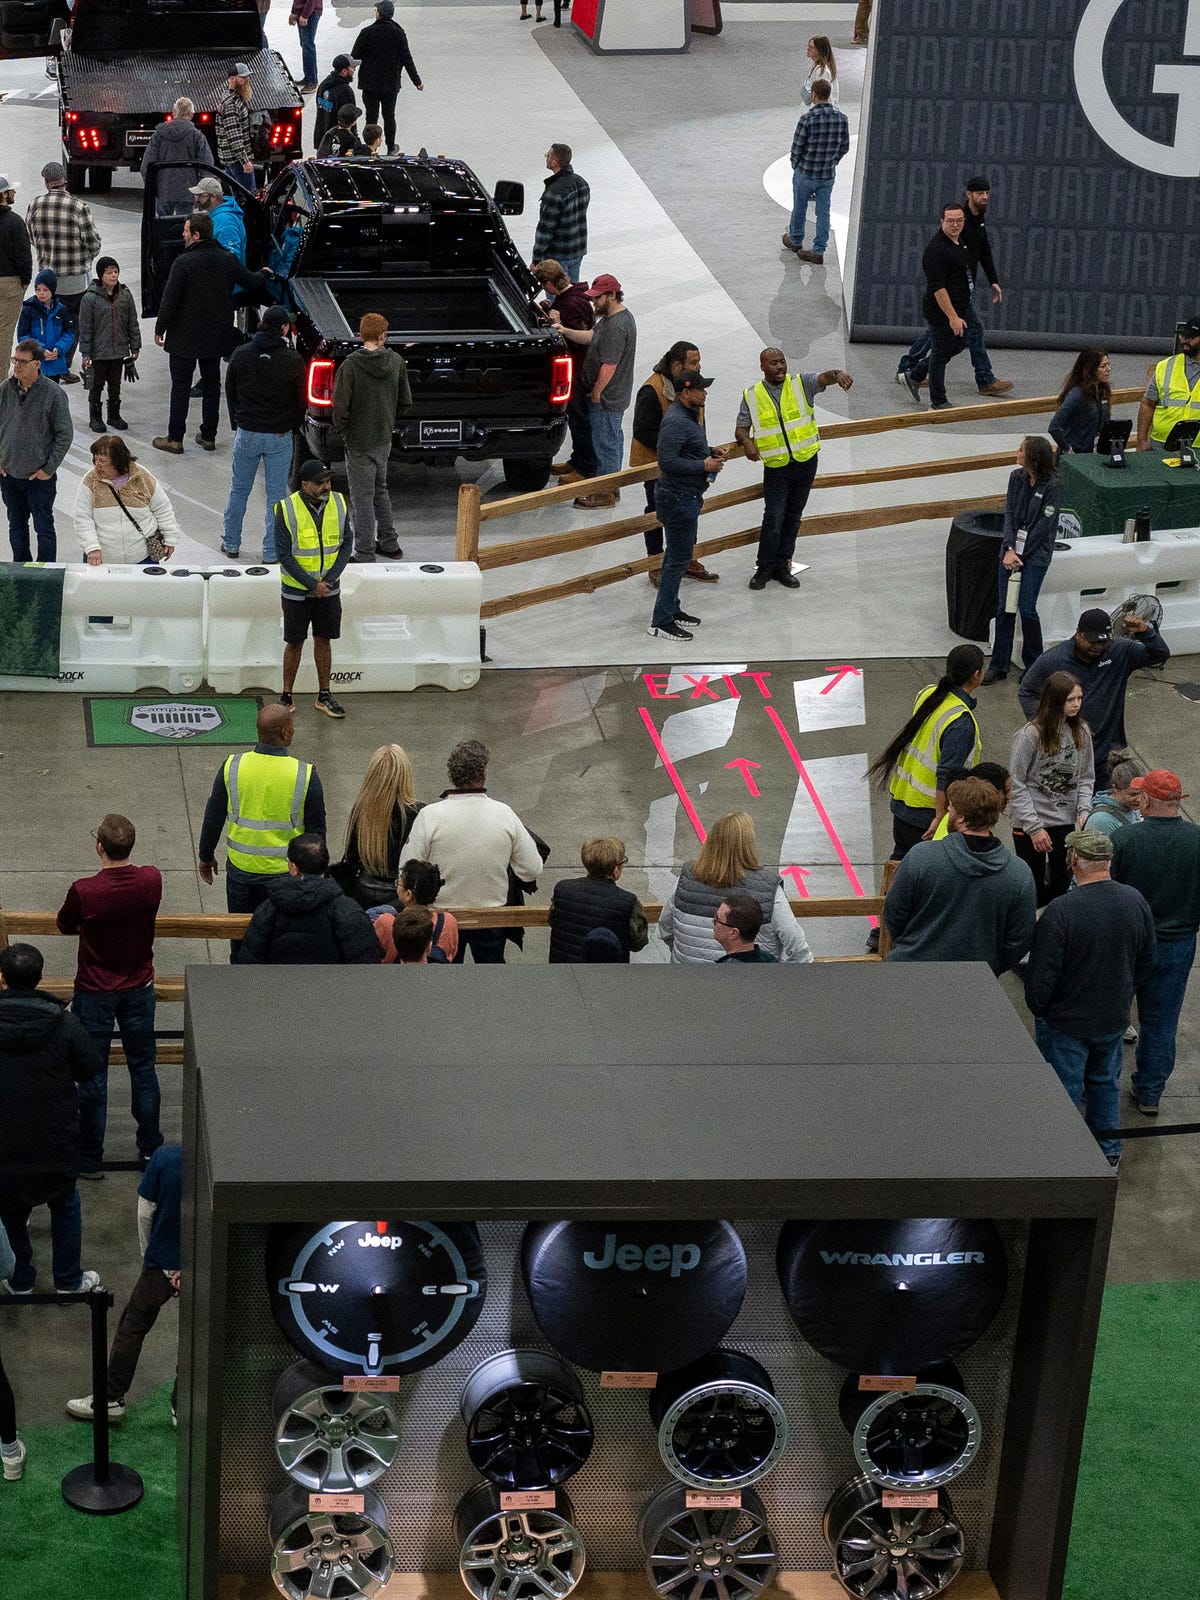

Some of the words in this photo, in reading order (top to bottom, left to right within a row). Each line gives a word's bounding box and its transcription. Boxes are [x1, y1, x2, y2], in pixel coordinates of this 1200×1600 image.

[888, 36, 960, 92] FIAT
[965, 38, 1037, 93] FIAT
[882, 98, 955, 154] FIAT
[959, 101, 1033, 156] FIAT
[877, 160, 950, 216] FIAT
[1030, 166, 1104, 222] FIAT
[1024, 228, 1098, 284] FIAT
[1101, 230, 1176, 286] FIAT
[1098, 659, 1113, 667] Jeep
[642, 671, 772, 699] EXIT
[179, 702, 212, 712] Jeep
[328, 1239, 345, 1257] NW
[358, 1233, 403, 1249] Jeep
[583, 1234, 701, 1277] Jeep
[819, 1250, 985, 1267] WRANGLER
[319, 1283, 340, 1293] W
[422, 1285, 437, 1295] E
[367, 1332, 382, 1341] S
